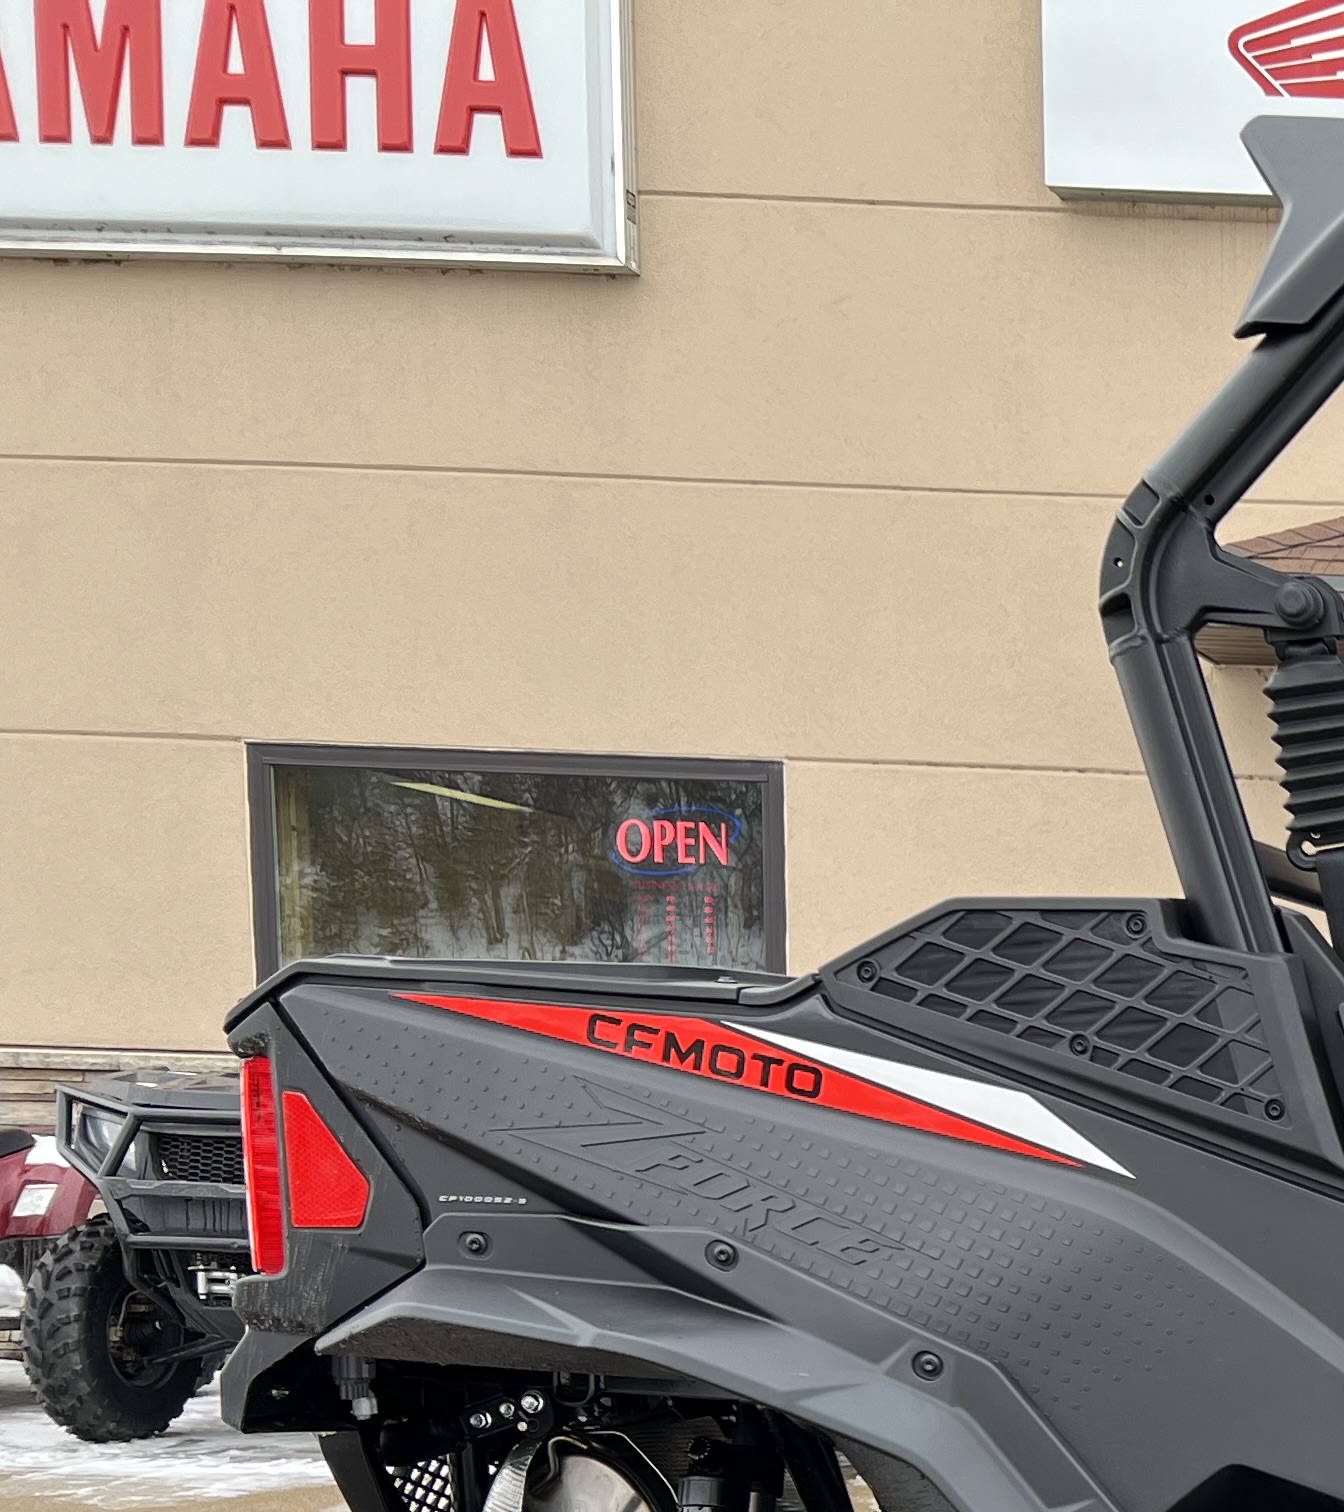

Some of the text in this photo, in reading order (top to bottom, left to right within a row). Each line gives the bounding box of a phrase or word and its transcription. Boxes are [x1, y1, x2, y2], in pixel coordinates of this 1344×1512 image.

[0, 0, 543, 159] MAHA
[615, 818, 729, 866] OPEN
[586, 1013, 823, 1101] CFMOTO
[634, 1152, 900, 1267] FORCE
